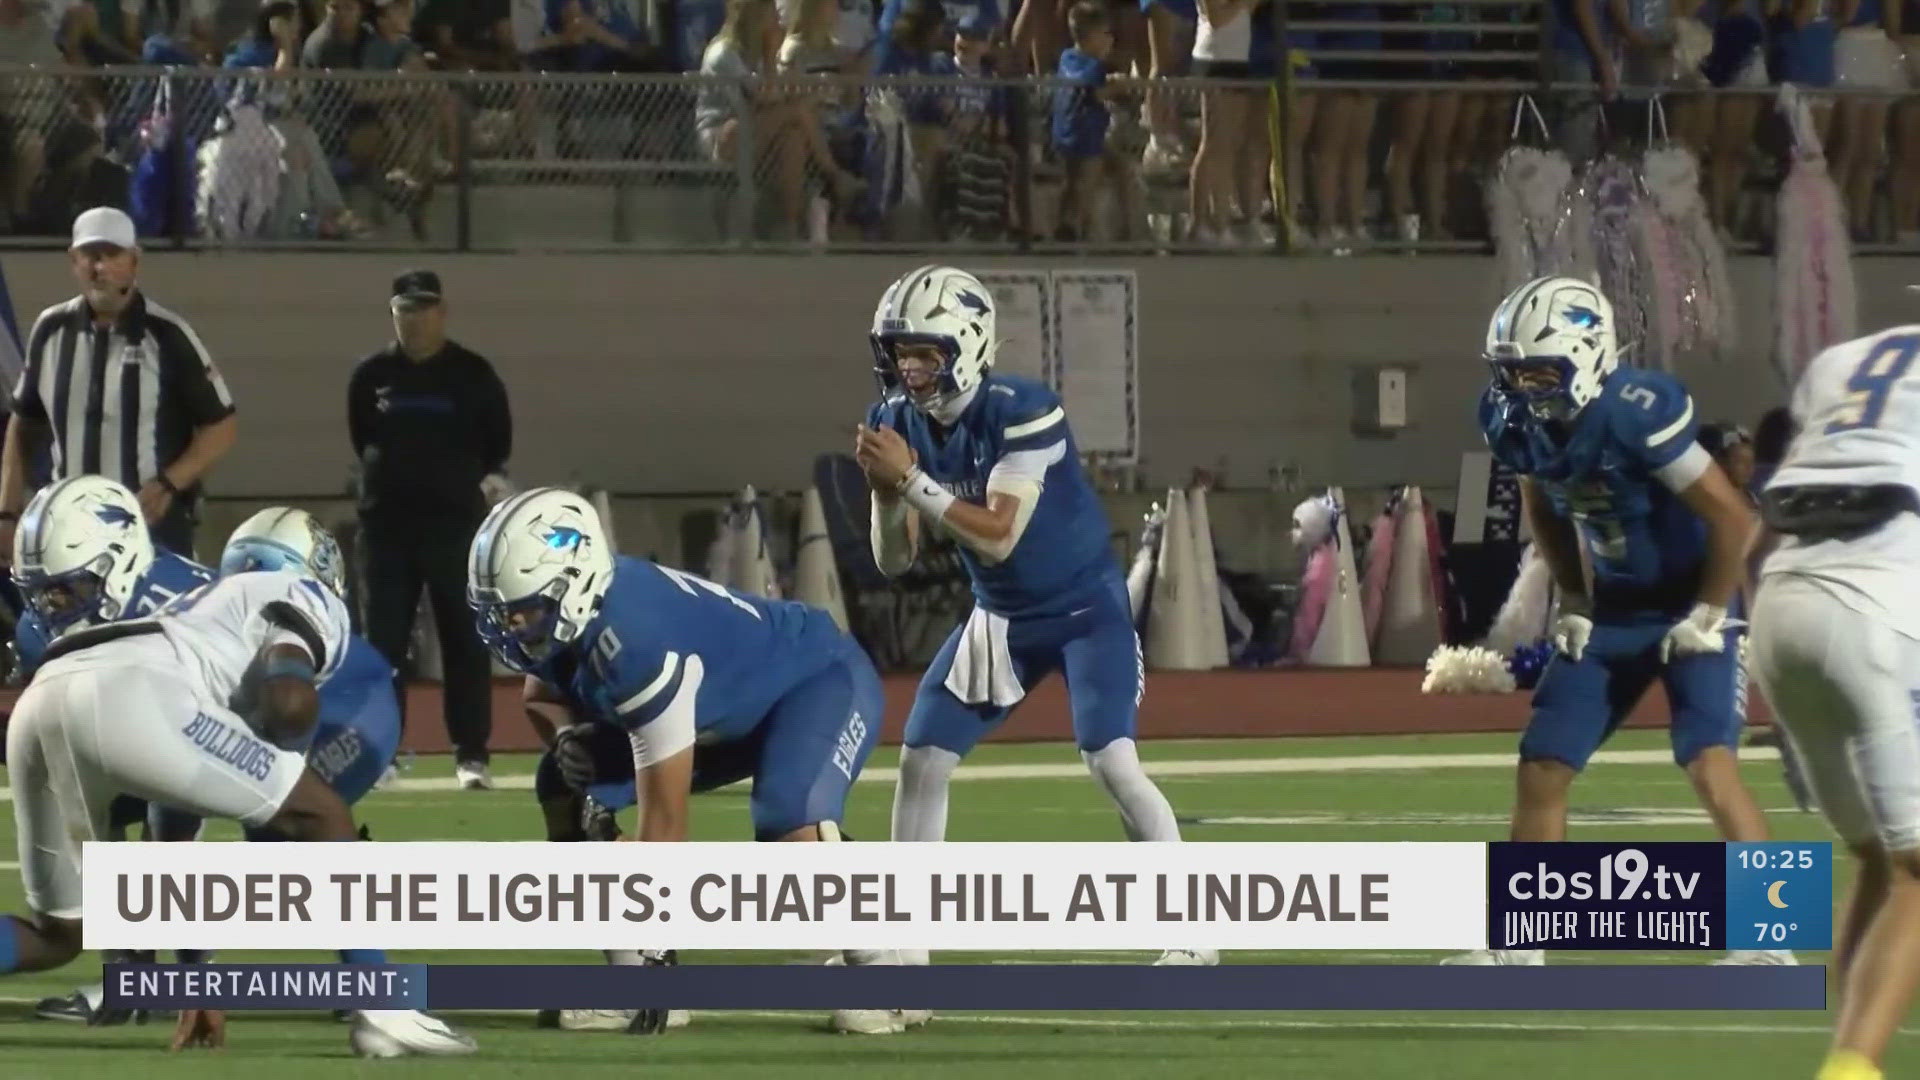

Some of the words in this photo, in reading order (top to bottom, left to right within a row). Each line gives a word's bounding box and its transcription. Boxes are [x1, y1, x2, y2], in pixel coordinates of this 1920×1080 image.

[1619, 383, 1657, 411] 5
[1822, 333, 1920, 436] 9
[182, 710, 276, 782] BULLDOGS
[832, 710, 868, 781] EAGLES
